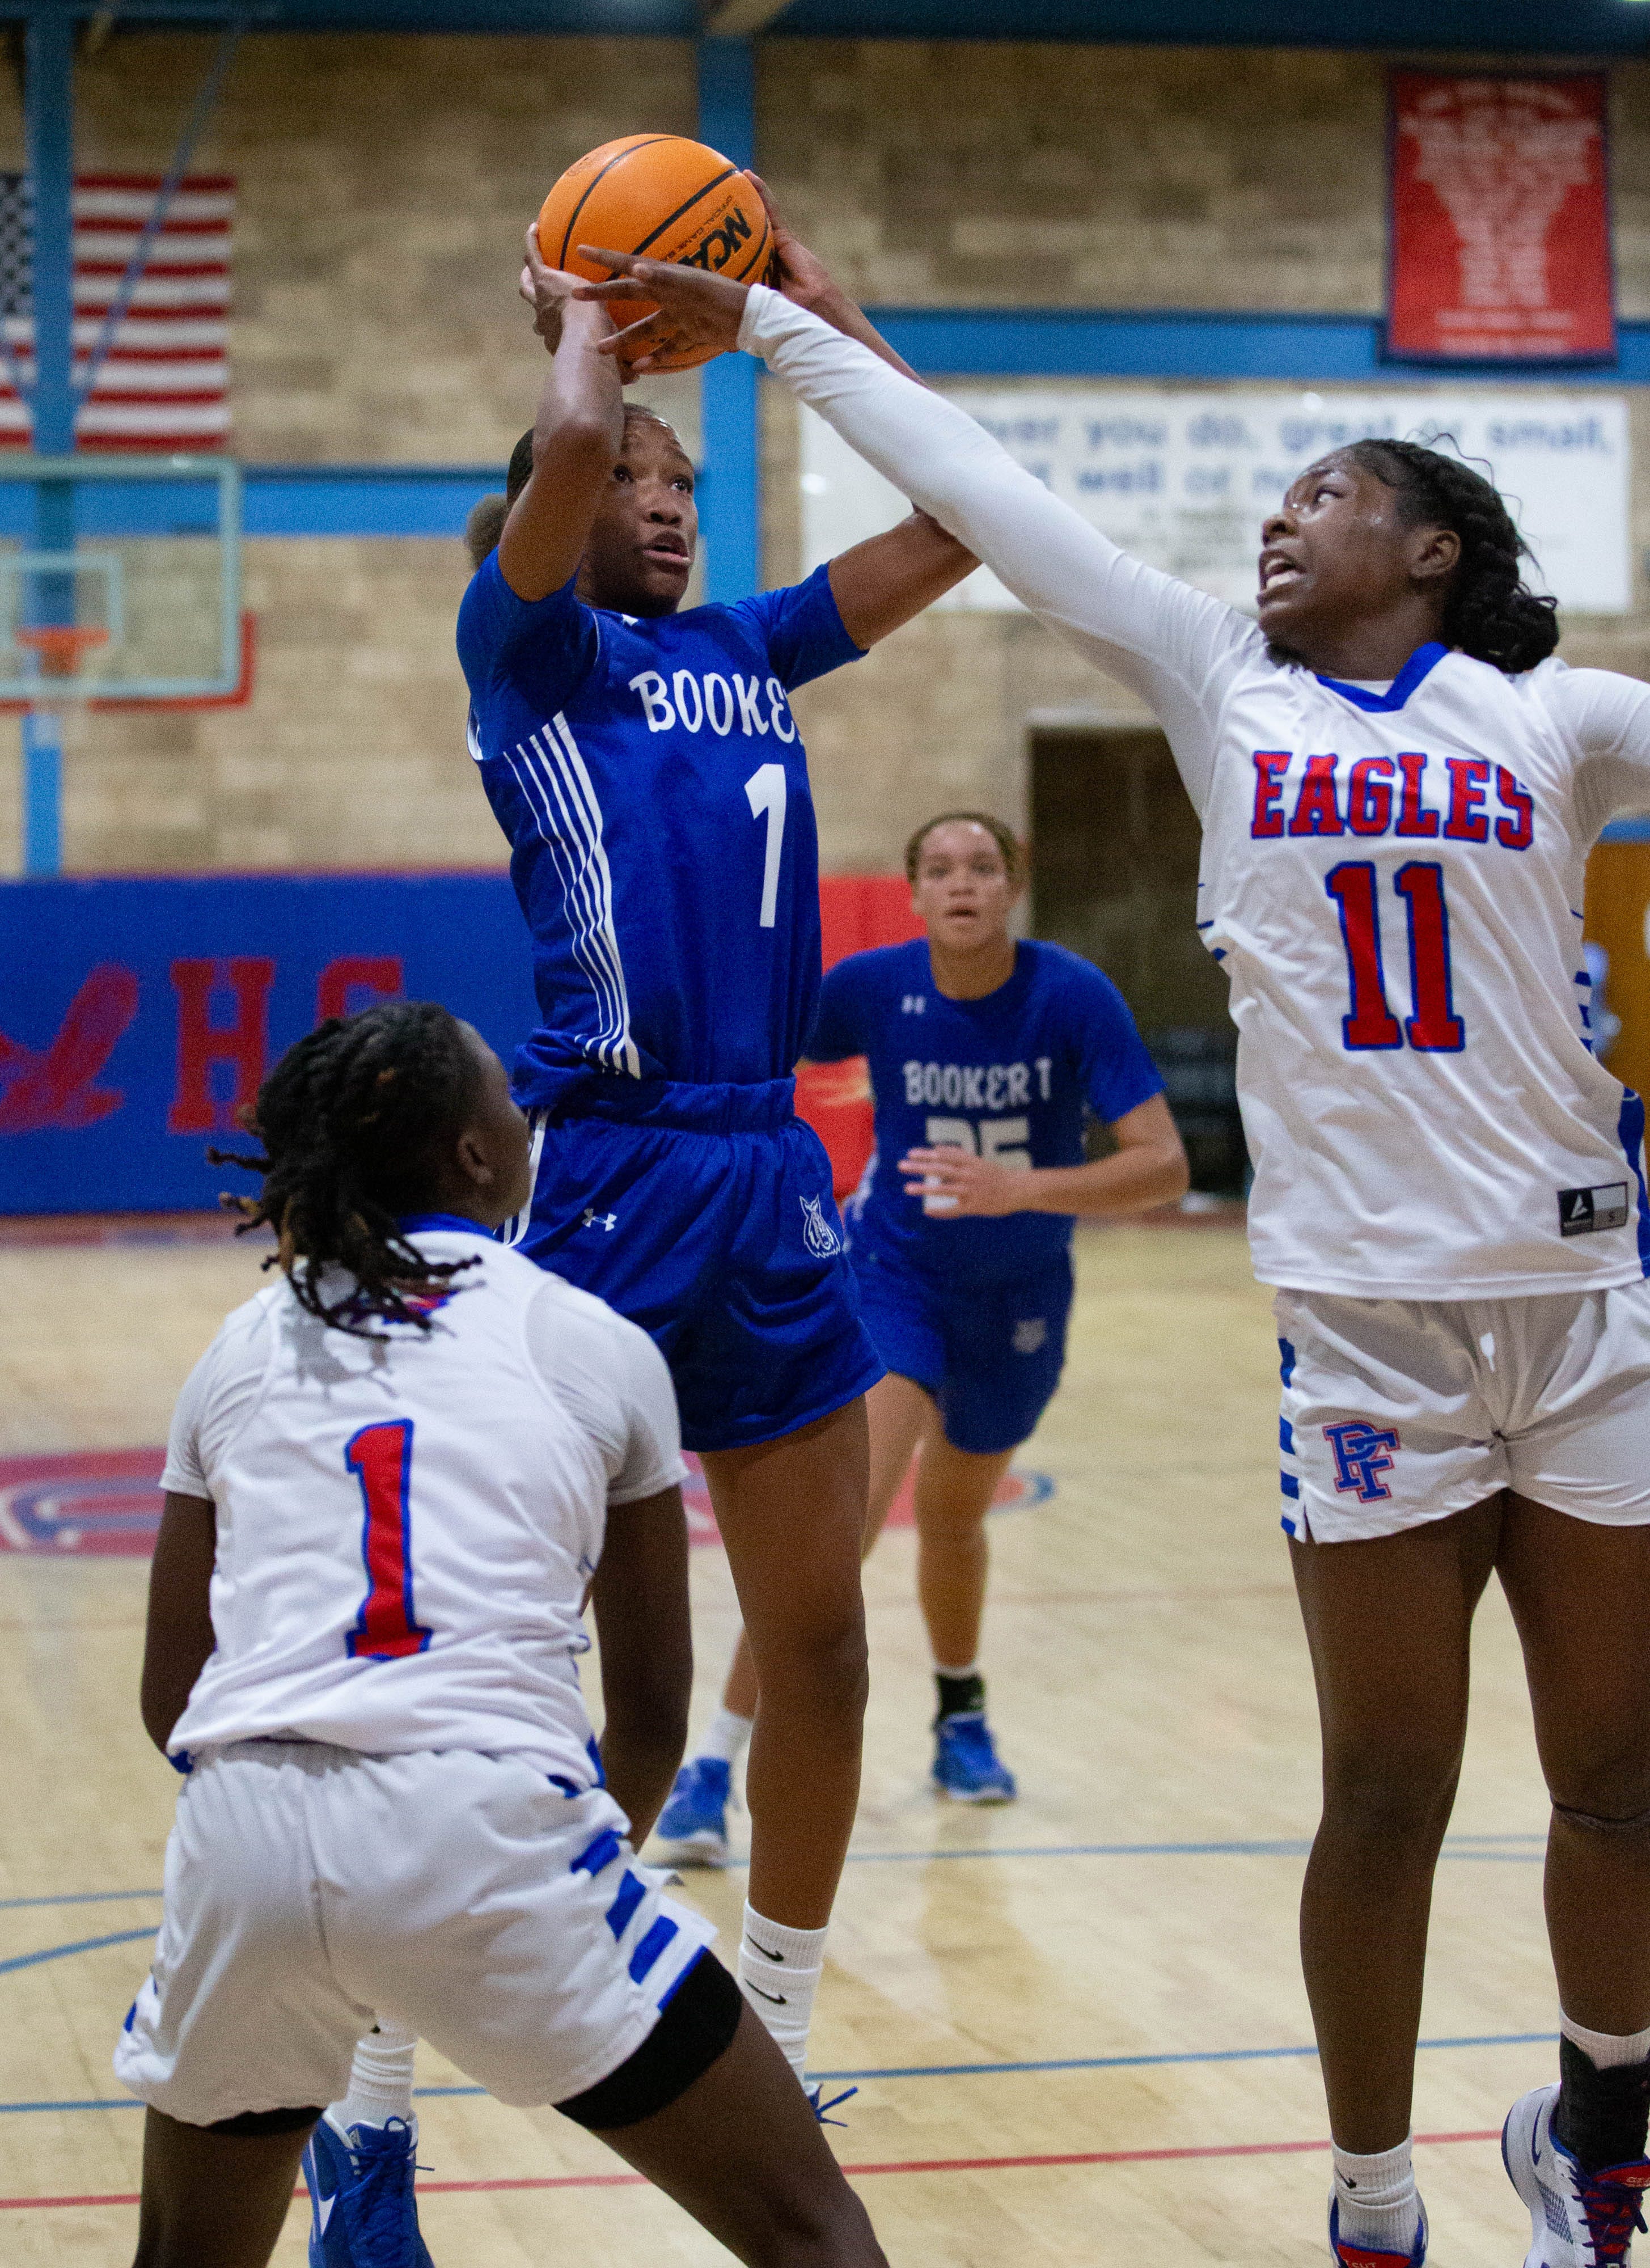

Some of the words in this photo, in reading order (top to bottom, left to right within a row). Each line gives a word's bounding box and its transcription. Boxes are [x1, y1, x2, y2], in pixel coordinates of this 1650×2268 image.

[677, 207, 752, 272] NCA
[628, 669, 804, 746] BOOKE
[744, 763, 786, 928] 1
[1251, 750, 1534, 851] EAGLES
[1325, 860, 1465, 1053] 11
[903, 1059, 1032, 1110] BOOKER
[344, 1417, 433, 1662] 1
